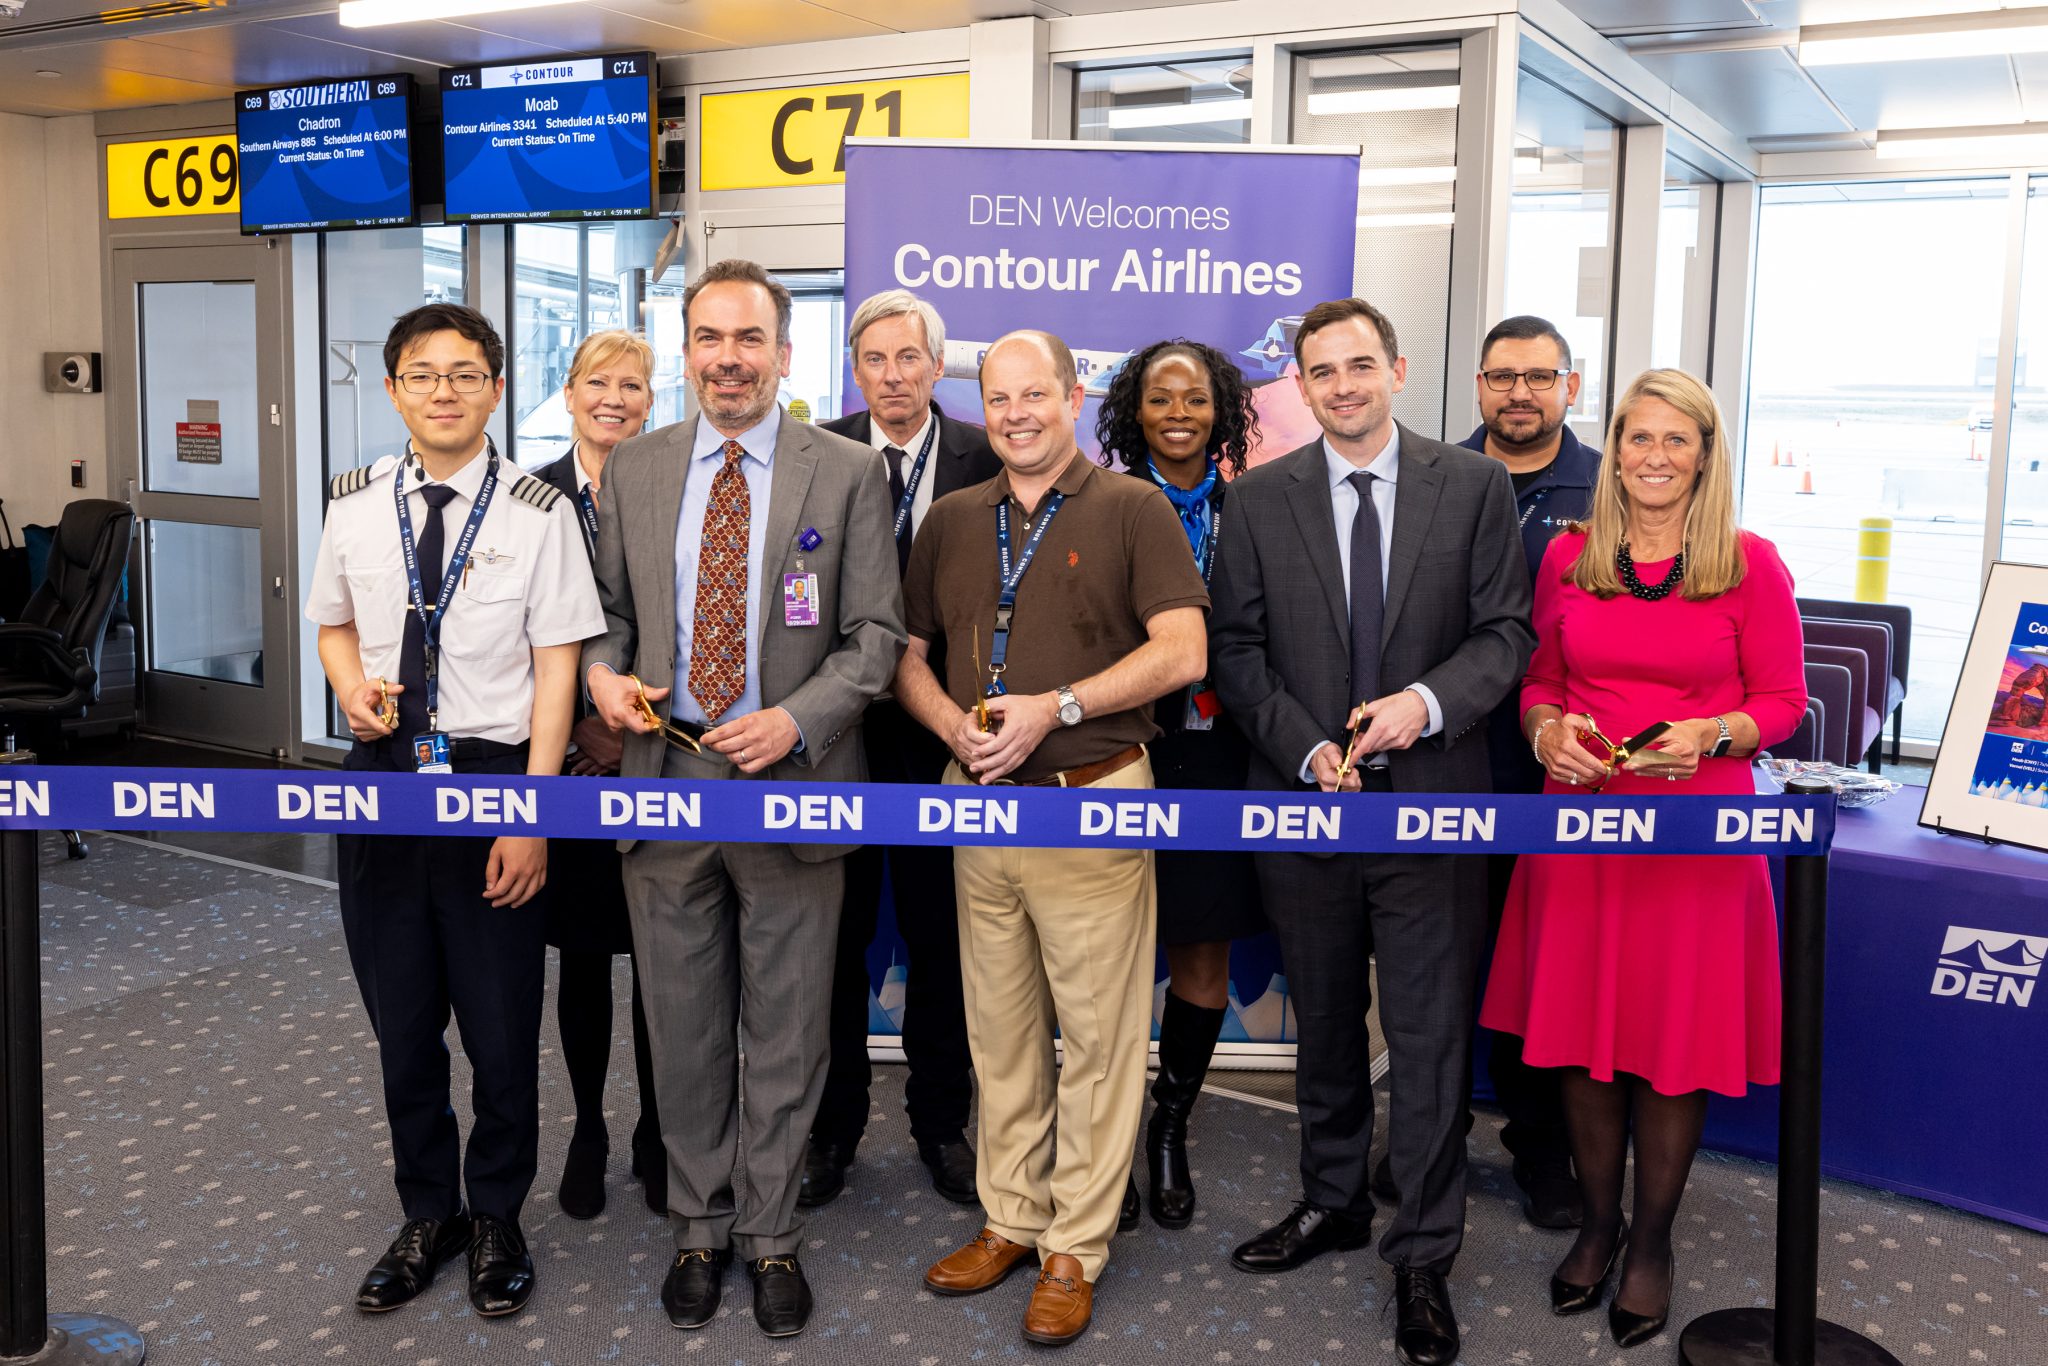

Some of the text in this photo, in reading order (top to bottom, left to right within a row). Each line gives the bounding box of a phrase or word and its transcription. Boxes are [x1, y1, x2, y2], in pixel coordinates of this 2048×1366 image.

[451, 61, 636, 87] C71 CONTOUR C71
[245, 80, 396, 109] C69 SOUTHERN C69
[525, 96, 559, 112] Moab
[298, 116, 341, 131] Chadron
[445, 112, 646, 135] Contour Airlines 3341 Scheduled At 5:40 PM
[771, 90, 902, 175] C71
[239, 129, 407, 153] Southern Airways 885 Scheduled At 6:00 PM
[491, 132, 596, 147] Current Status: On Time
[279, 148, 364, 164] Current Status: On Time
[144, 144, 237, 208] C69
[969, 194, 1230, 231] DEN Welcomes
[894, 243, 1302, 296] Contour Airlines
[479, 475, 494, 507] CONTOUR
[908, 468, 921, 494] CONTOUR
[396, 487, 407, 519] CONTOUR
[586, 508, 599, 532] CONTOUR
[1032, 513, 1052, 541] CONTOUR
[404, 537, 415, 570] CONTOUR
[457, 524, 476, 556] CONTOUR
[1001, 547, 1010, 576] CONTOUR
[1009, 557, 1028, 586] CONTOUR
[439, 574, 456, 607] CONTOUR
[2028, 622, 2048, 635] Co
[114, 782, 214, 818] DEN
[278, 785, 378, 820] DEN
[437, 788, 536, 823] DEN
[601, 791, 700, 827] DEN
[764, 795, 862, 830] DEN
[919, 798, 1018, 833] DEN
[1081, 802, 1179, 837] DEN
[1242, 805, 1341, 839] DEN
[1397, 808, 1495, 840] DEN
[1557, 809, 1655, 841] DEN
[1716, 809, 1813, 841] DEN
[1930, 967, 2036, 1008] DEN
